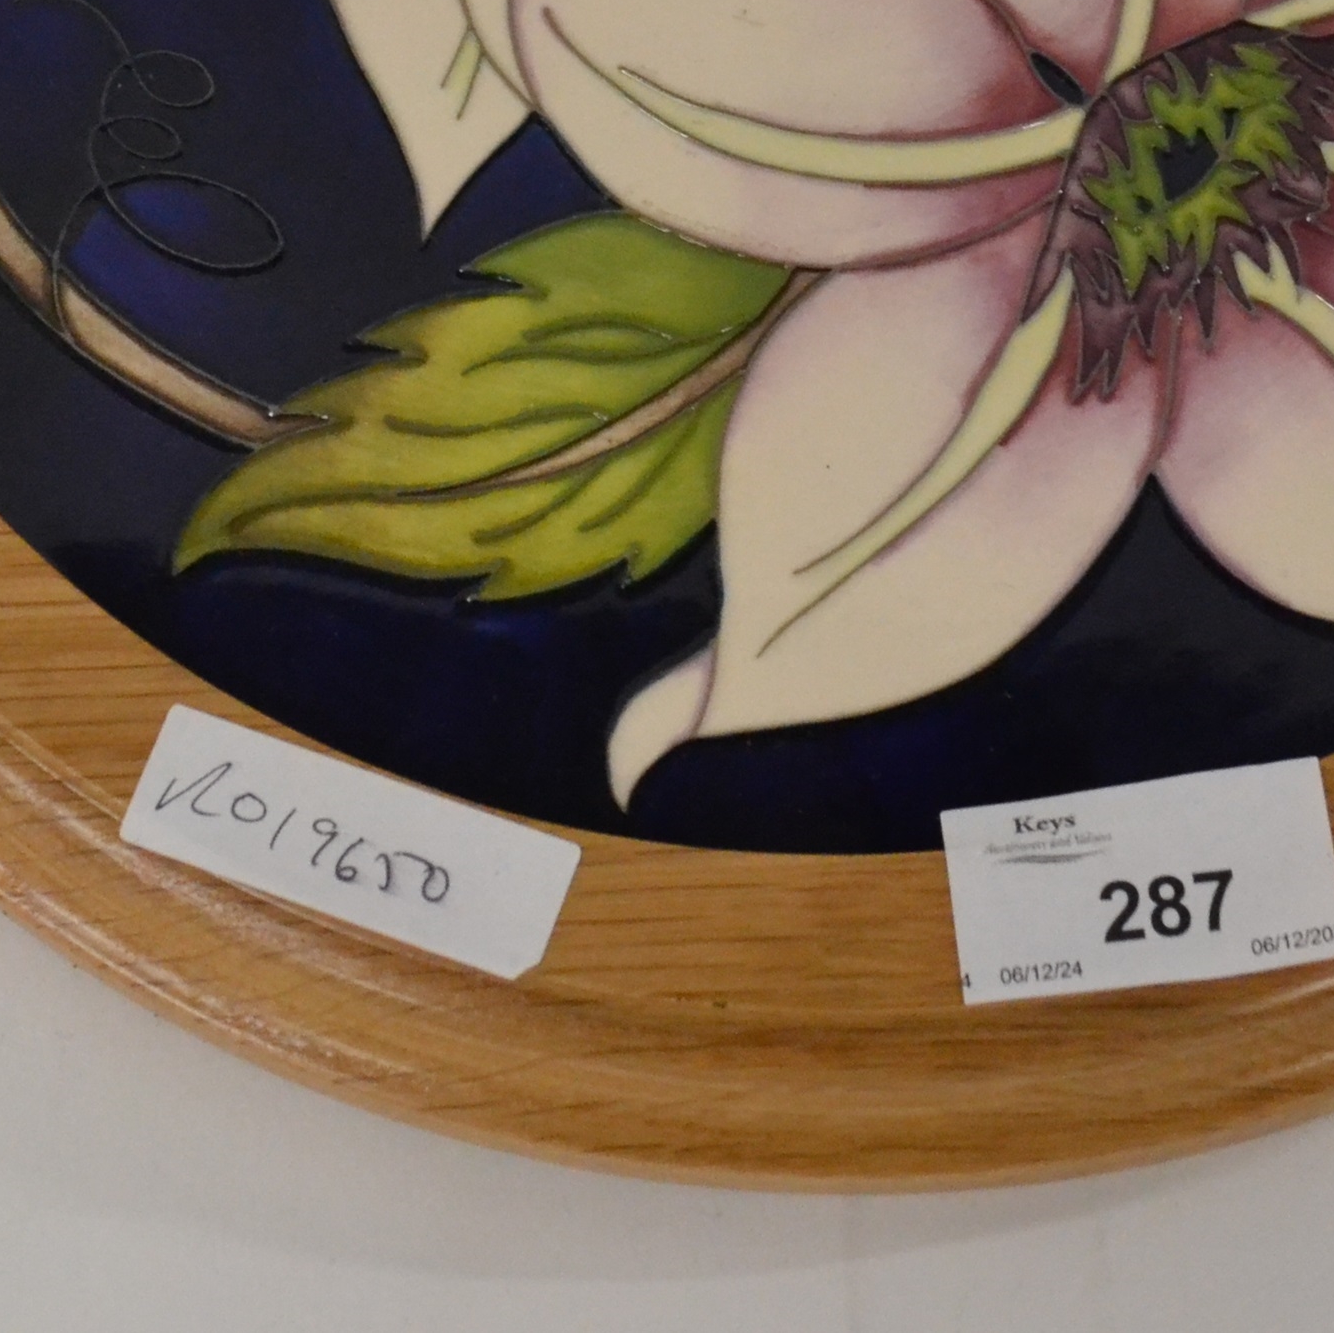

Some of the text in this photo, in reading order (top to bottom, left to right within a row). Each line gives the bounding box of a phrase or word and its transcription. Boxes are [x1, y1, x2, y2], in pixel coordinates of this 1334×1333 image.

[1013, 815, 1077, 835] Keys
[1099, 869, 1233, 943] 287
[999, 960, 1083, 985] 06/12/24
